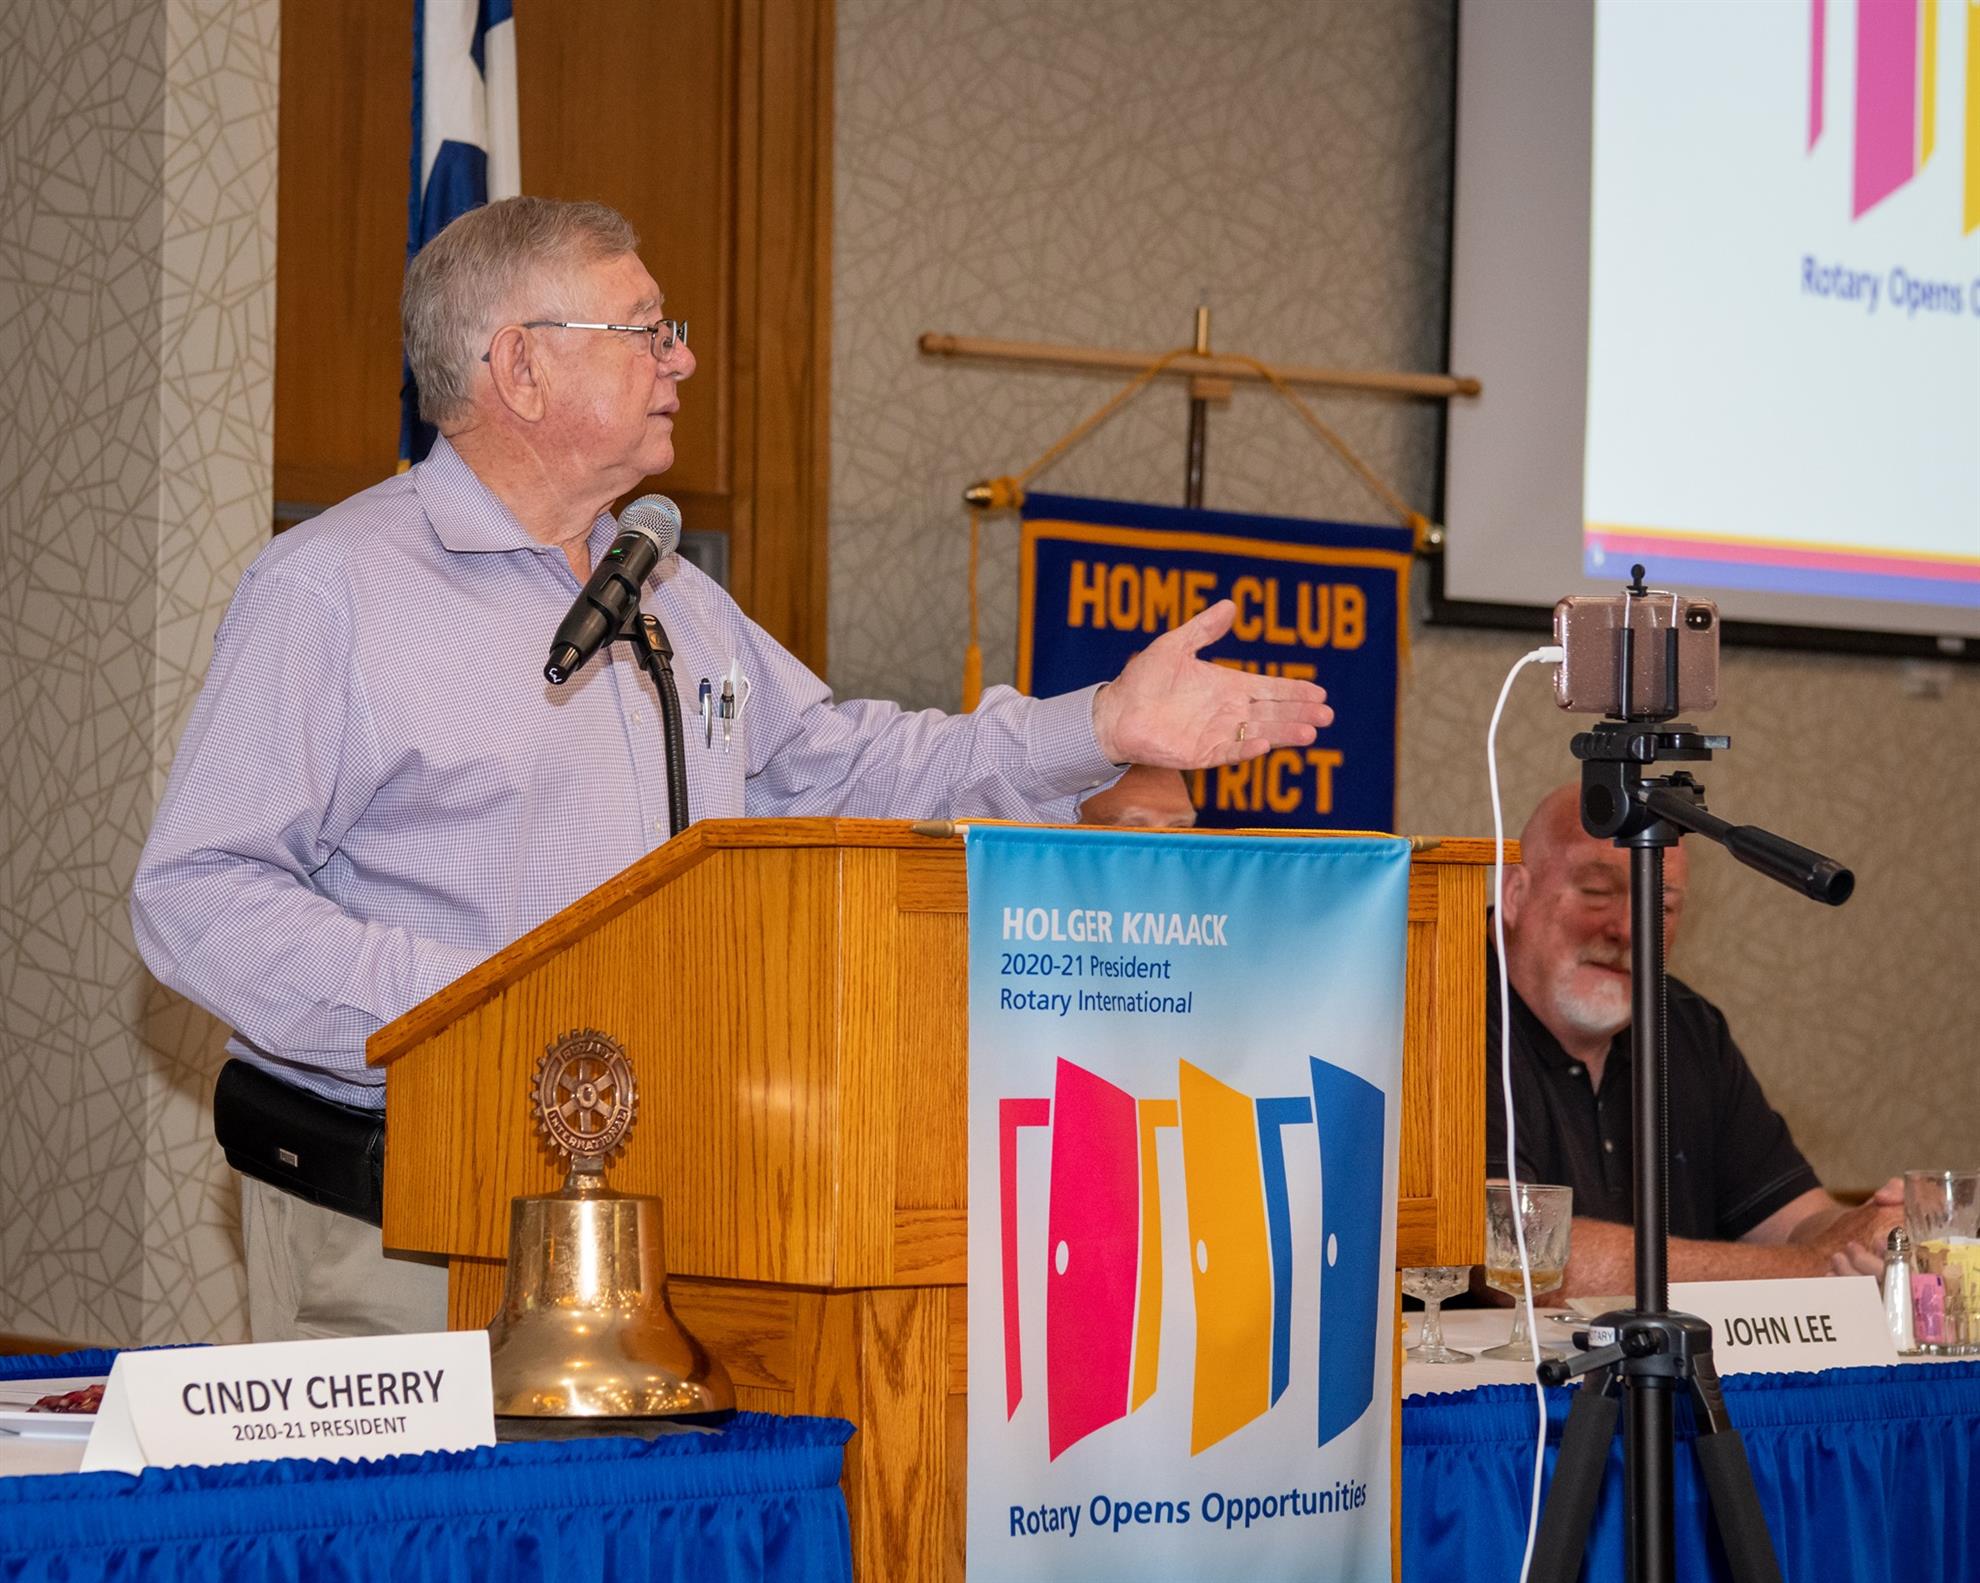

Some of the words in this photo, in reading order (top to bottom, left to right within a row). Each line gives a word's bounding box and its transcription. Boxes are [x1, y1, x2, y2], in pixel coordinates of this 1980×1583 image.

[1801, 255, 1881, 316] Rotary
[1889, 265, 1963, 321] Opens
[1067, 560, 1218, 634] HOME
[1231, 576, 1367, 650] CLUB
[1002, 906, 1113, 944] HOLGER
[1121, 911, 1229, 946] KNAACK
[1000, 953, 1084, 977] 2020-21
[1090, 955, 1172, 979] President
[1000, 988, 1072, 1016] Rotary
[1078, 990, 1193, 1013] International
[562, 1041, 616, 1061] ROTARY
[549, 1109, 629, 1151] INTERNATIONAL
[1724, 1317, 1792, 1347] JOHN
[1794, 1314, 1837, 1344] LEE
[181, 1377, 293, 1417] CINDY
[305, 1369, 445, 1409] CHERRY
[232, 1422, 306, 1442] 2020-21
[311, 1416, 407, 1438] PRESIDENT
[1009, 1504, 1081, 1538] Rotary
[1089, 1495, 1191, 1532] Opens
[1201, 1479, 1367, 1530] Opportunities
